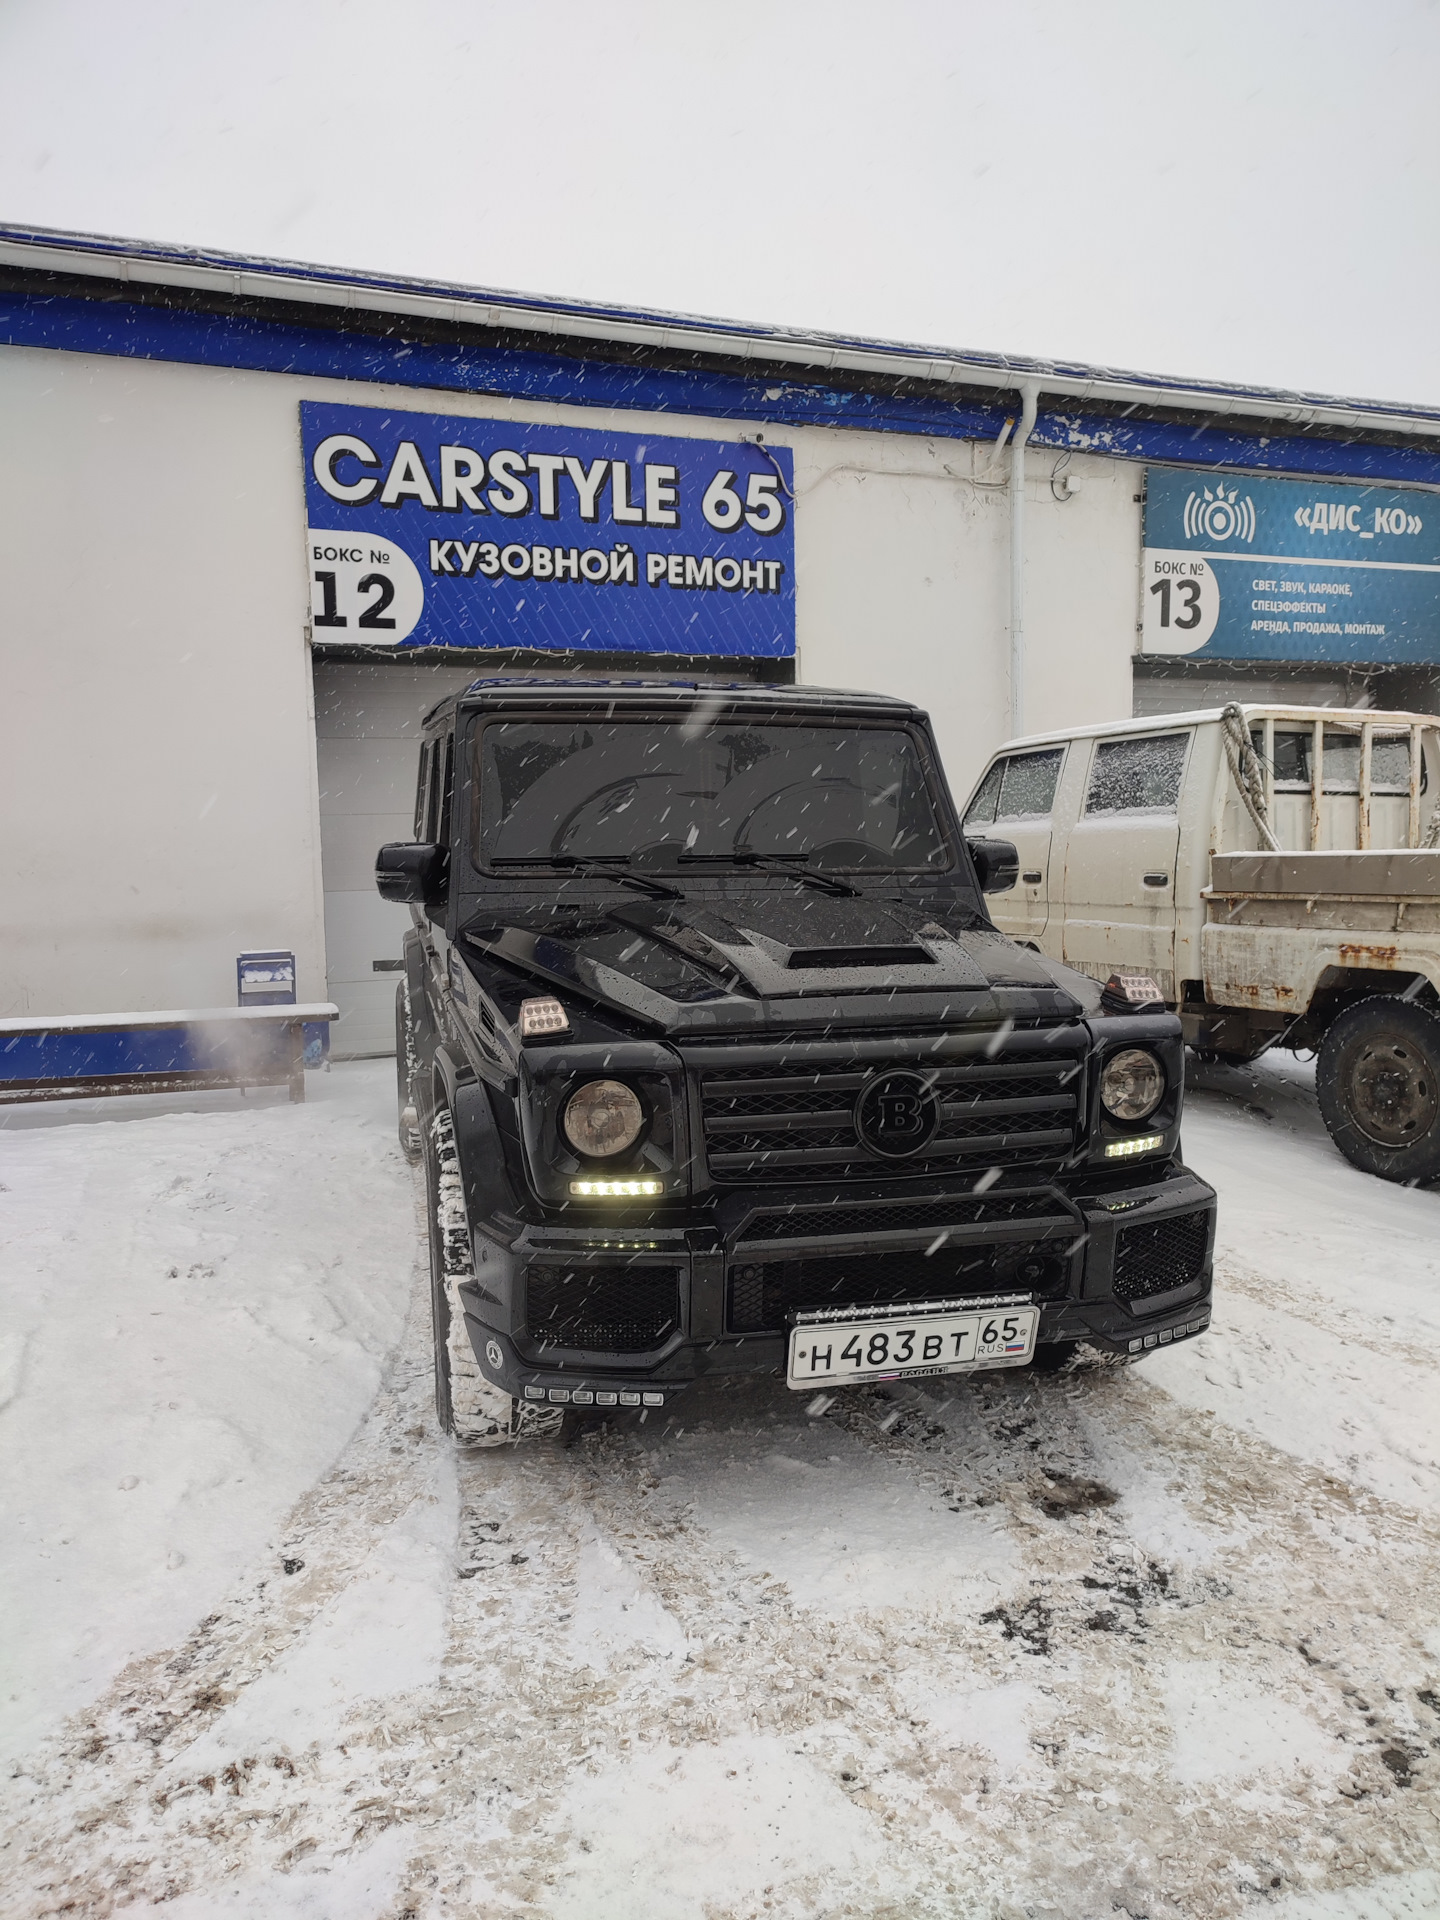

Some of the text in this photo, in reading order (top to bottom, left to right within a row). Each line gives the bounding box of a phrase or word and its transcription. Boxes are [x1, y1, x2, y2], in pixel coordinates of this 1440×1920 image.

[312, 433, 788, 535] CARSTYLE 65
[1294, 502, 1423, 539] «ДИС_КО»
[313, 546, 391, 565] БОКС №
[429, 538, 783, 593] КУЗОВНОЙ РЕМОНТ
[1154, 561, 1204, 576] БОКС №
[1252, 579, 1353, 597] СВЕТ, ЗВУК, КАРАОКЕ,
[314, 571, 397, 629] 12
[1150, 578, 1202, 629] 13
[1251, 600, 1326, 614] СПЕЦЭФФЕКТЫ
[1251, 620, 1385, 636] АРЕНДА, ПРОДАЖА, МОНТАЖ
[981, 1317, 1020, 1344] 65
[977, 1343, 1004, 1355] RUS
